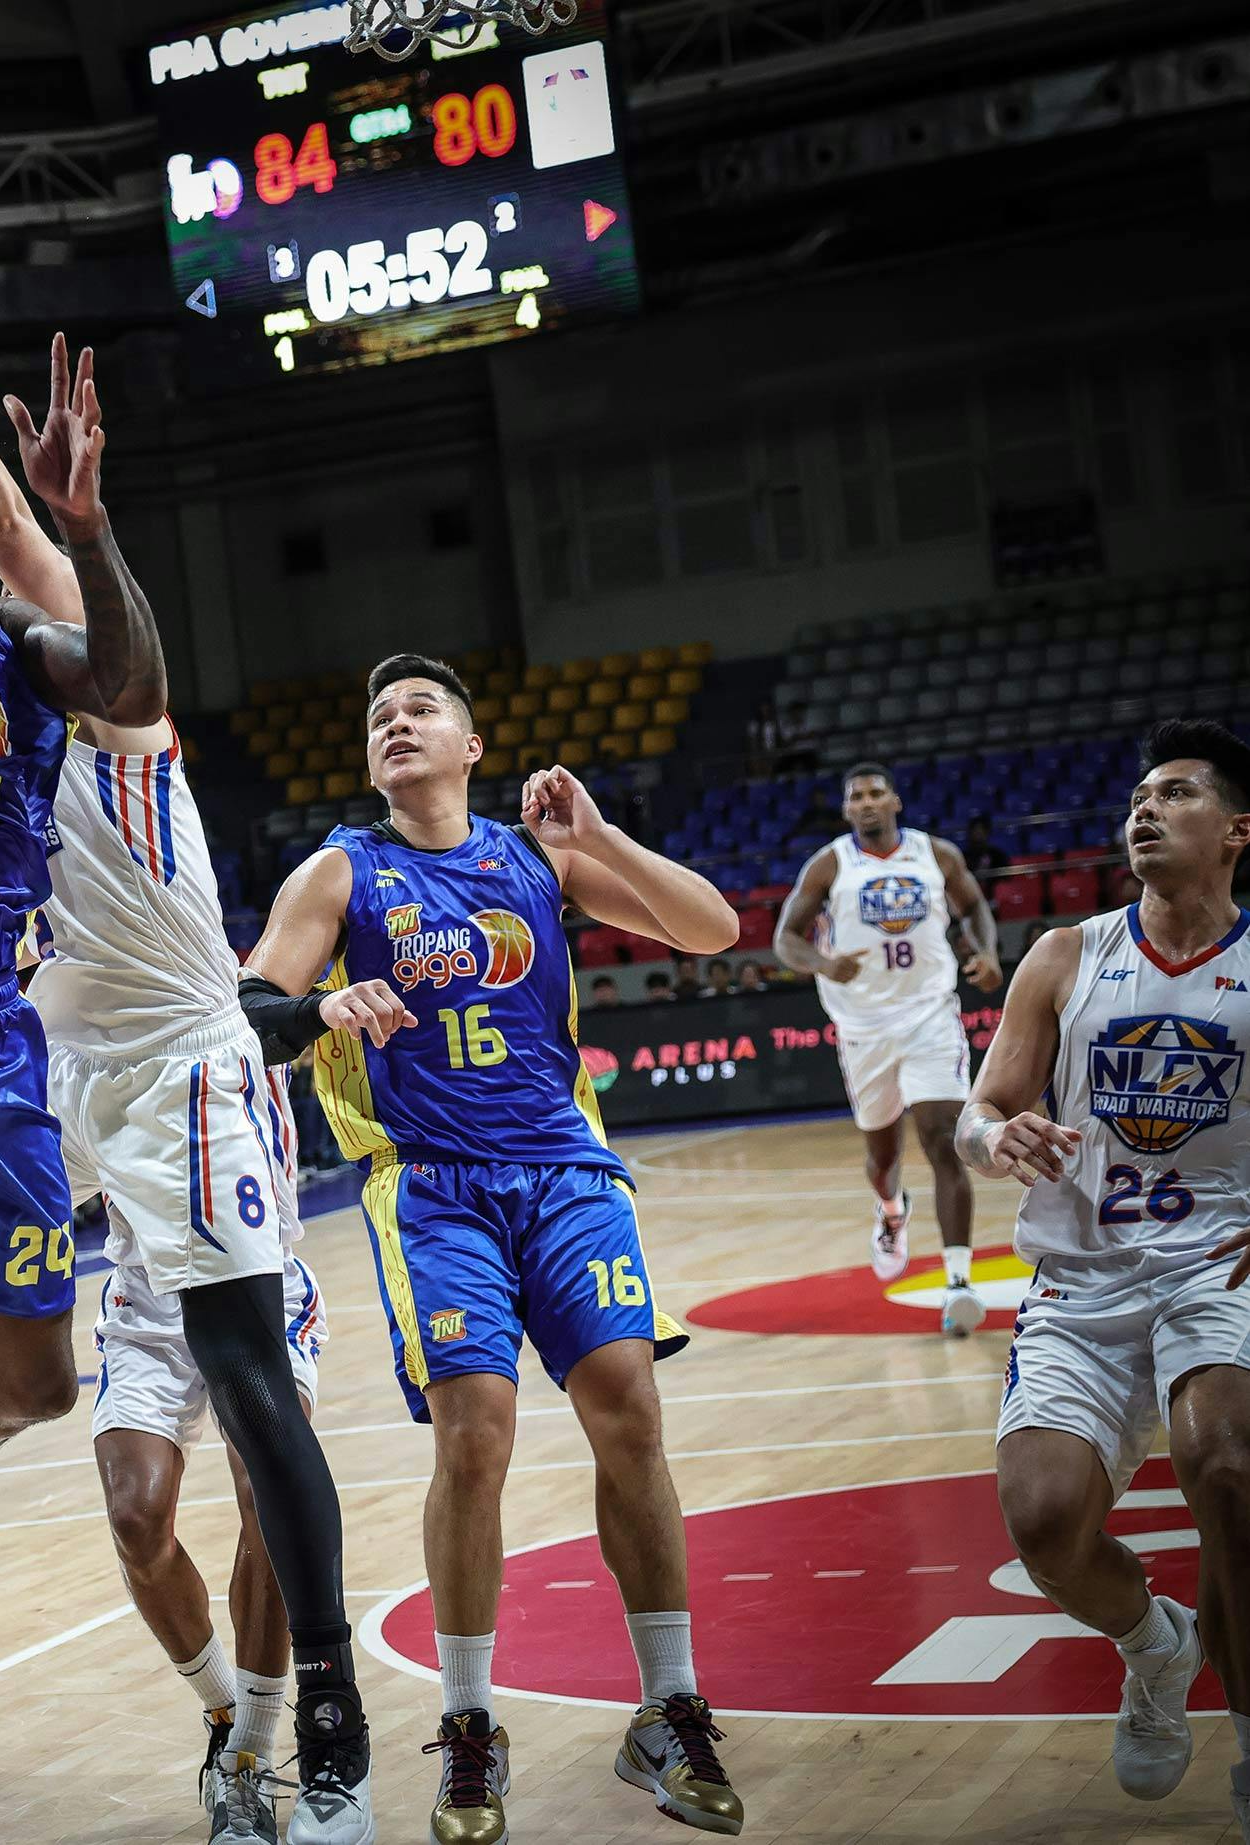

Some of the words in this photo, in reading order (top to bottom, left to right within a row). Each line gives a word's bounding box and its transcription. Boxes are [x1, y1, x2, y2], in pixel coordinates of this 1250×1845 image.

[433, 83, 517, 166] 80
[254, 122, 337, 204] 84
[306, 220, 492, 322] 05:52
[274, 336, 295, 371] 1
[387, 905, 421, 937] TNT
[392, 927, 471, 960] TROPANG
[883, 941, 913, 969] 18
[438, 1004, 508, 1069] 16
[631, 1036, 757, 1073] ARENA
[770, 1027, 821, 1050] The
[651, 1061, 737, 1087] PLUS
[1093, 1050, 1237, 1099] NLEX
[1093, 1094, 1129, 1115] ROAD
[1136, 1097, 1227, 1120] WARRIORS
[236, 1175, 266, 1229] 8
[1099, 1164, 1196, 1226] 26
[5, 1223, 74, 1287] 24
[587, 1254, 646, 1309] 16
[429, 1310, 465, 1341] TNT
